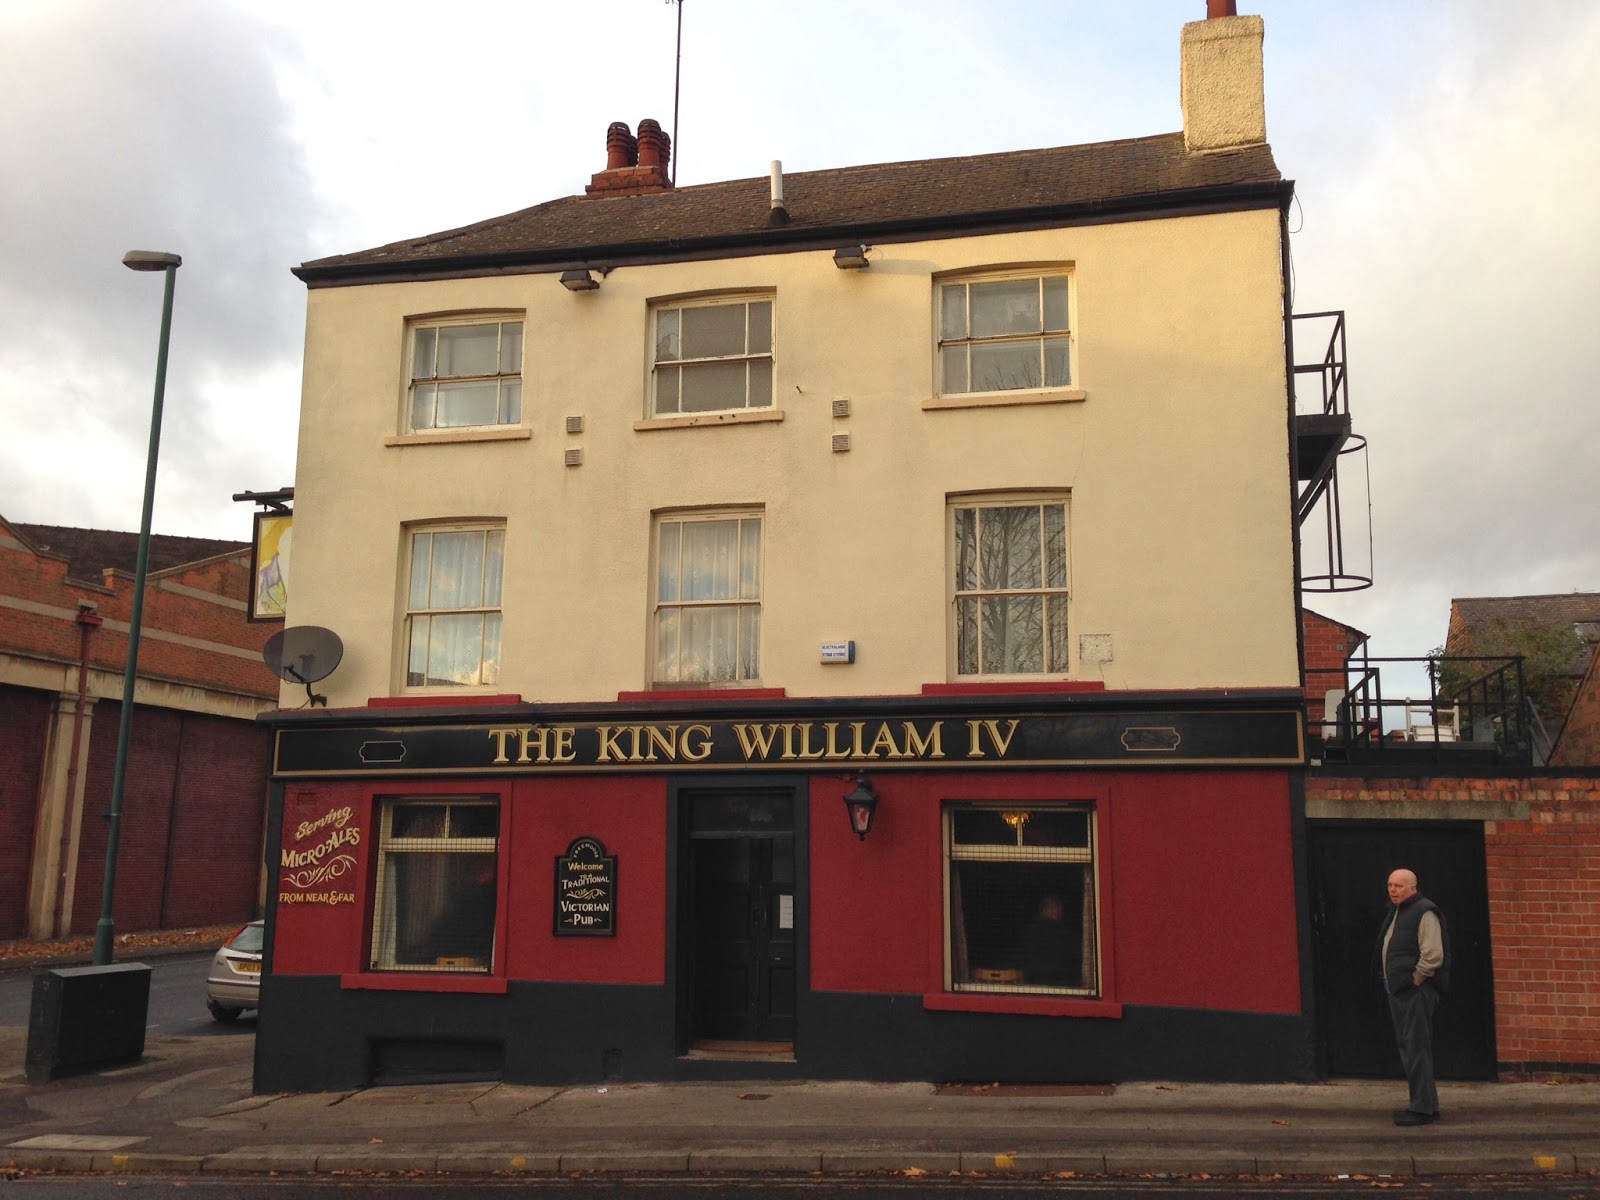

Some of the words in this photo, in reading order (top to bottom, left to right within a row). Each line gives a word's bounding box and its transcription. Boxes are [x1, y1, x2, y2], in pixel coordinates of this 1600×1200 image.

[488, 726, 577, 764] THE
[595, 724, 714, 762] KING
[732, 721, 945, 760] WILLIAM
[965, 719, 1020, 758] IV
[295, 806, 353, 841] Serving
[568, 862, 603, 871] Welcome
[561, 876, 609, 889] TRADITIONAL
[280, 892, 304, 904] FROM
[561, 900, 610, 912] VICTORIAN
